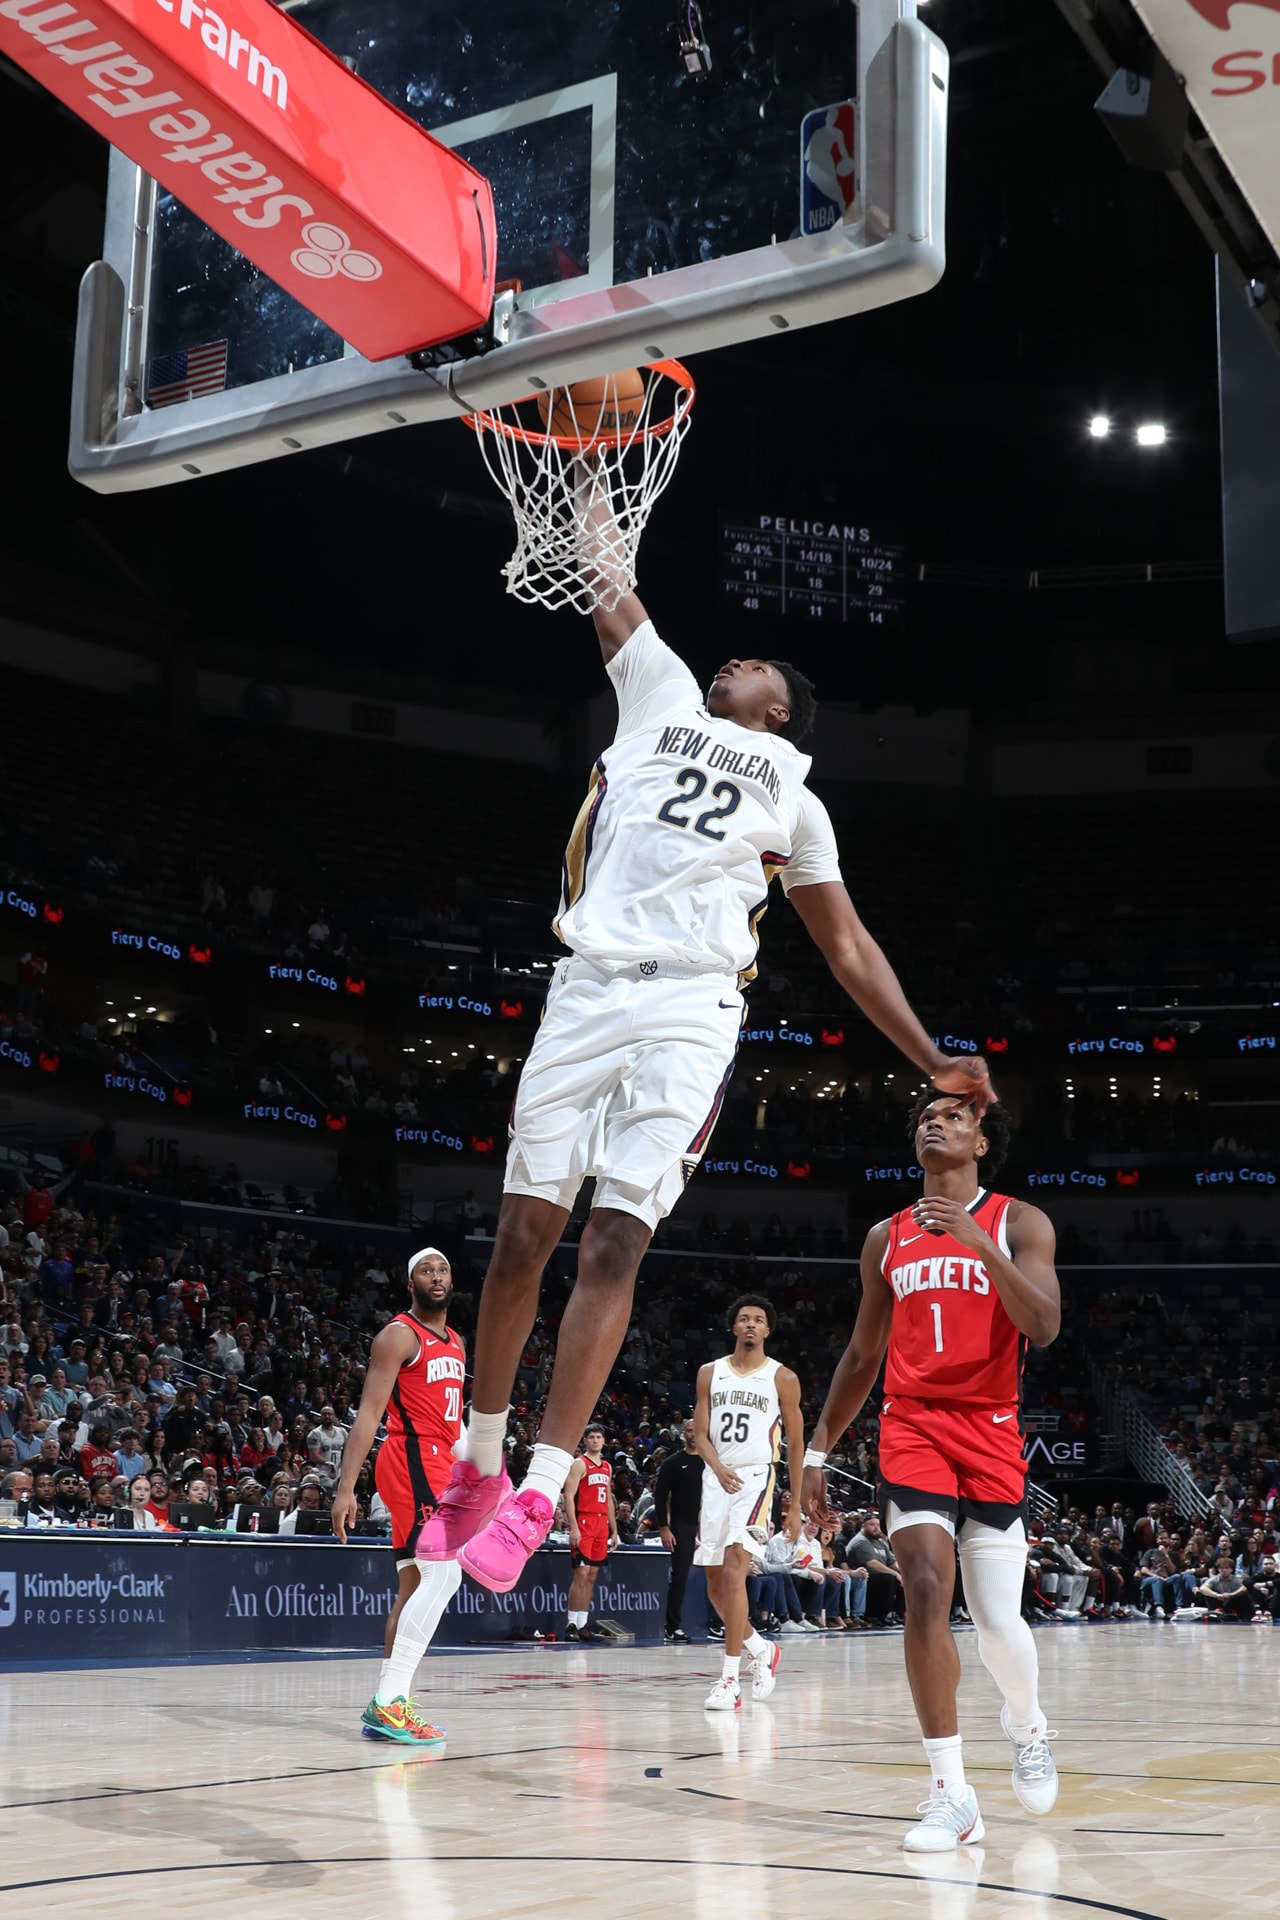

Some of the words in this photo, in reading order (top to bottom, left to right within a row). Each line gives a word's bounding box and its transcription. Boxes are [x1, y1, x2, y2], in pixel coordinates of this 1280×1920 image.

[156, 0, 288, 111] Farm
[809, 205, 836, 231] NBA
[760, 515, 871, 542] PELICANS
[734, 542, 773, 557] 49.4%
[800, 550, 832, 563] 14/18
[744, 570, 757, 581] 11
[860, 557, 893, 571] 10/24
[808, 577, 823, 589] 18
[868, 584, 883, 596] 29
[744, 598, 759, 610] 48
[809, 605, 823, 617] 11
[869, 612, 883, 624] 14
[653, 726, 712, 761] NEW
[656, 766, 743, 843] 22
[7, 891, 37, 918] Crab
[111, 928, 143, 949] Fiery
[147, 936, 181, 960] Crab
[268, 962, 302, 982] Fiery
[306, 969, 338, 991] Crab
[418, 992, 453, 1010] Fiery
[457, 996, 492, 1016] Crab
[738, 1027, 774, 1042] Fiery
[778, 1028, 813, 1046] Crab
[944, 1035, 978, 1052] Crab
[1068, 1039, 1105, 1055] Fiery
[1109, 1037, 1144, 1053] Crab
[1238, 1034, 1276, 1051] Fiery
[0, 1041, 32, 1068] Crab
[104, 1070, 135, 1092] Fiery
[138, 1078, 167, 1102] Crab
[243, 1101, 280, 1121] Fiery
[284, 1106, 318, 1129] Crab
[395, 1124, 428, 1143] Fiery
[432, 1129, 464, 1151] Crab
[704, 1156, 739, 1174] Fiery
[743, 1159, 779, 1178] Crab
[865, 1164, 902, 1181] Fiery
[907, 1166, 925, 1180] Cr
[1027, 1171, 1065, 1187] Fiery
[1070, 1170, 1107, 1187] Crab
[1195, 1168, 1234, 1186] Fiery
[1239, 1168, 1277, 1185] Crab
[890, 1256, 991, 1303] ROCKETS
[930, 1302, 944, 1353] 1
[444, 1386, 461, 1422] 20
[730, 1390, 769, 1413] ORLEANS
[720, 1412, 750, 1443] 25
[1023, 1434, 1087, 1465] AGE
[598, 1486, 607, 1503] 15
[225, 1585, 259, 1617] An
[265, 1582, 345, 1618] Official
[456, 1583, 485, 1614] the
[490, 1590, 528, 1614] New
[599, 1583, 660, 1612] Pelicans
[24, 1608, 166, 1625] PROFESSIONAL
